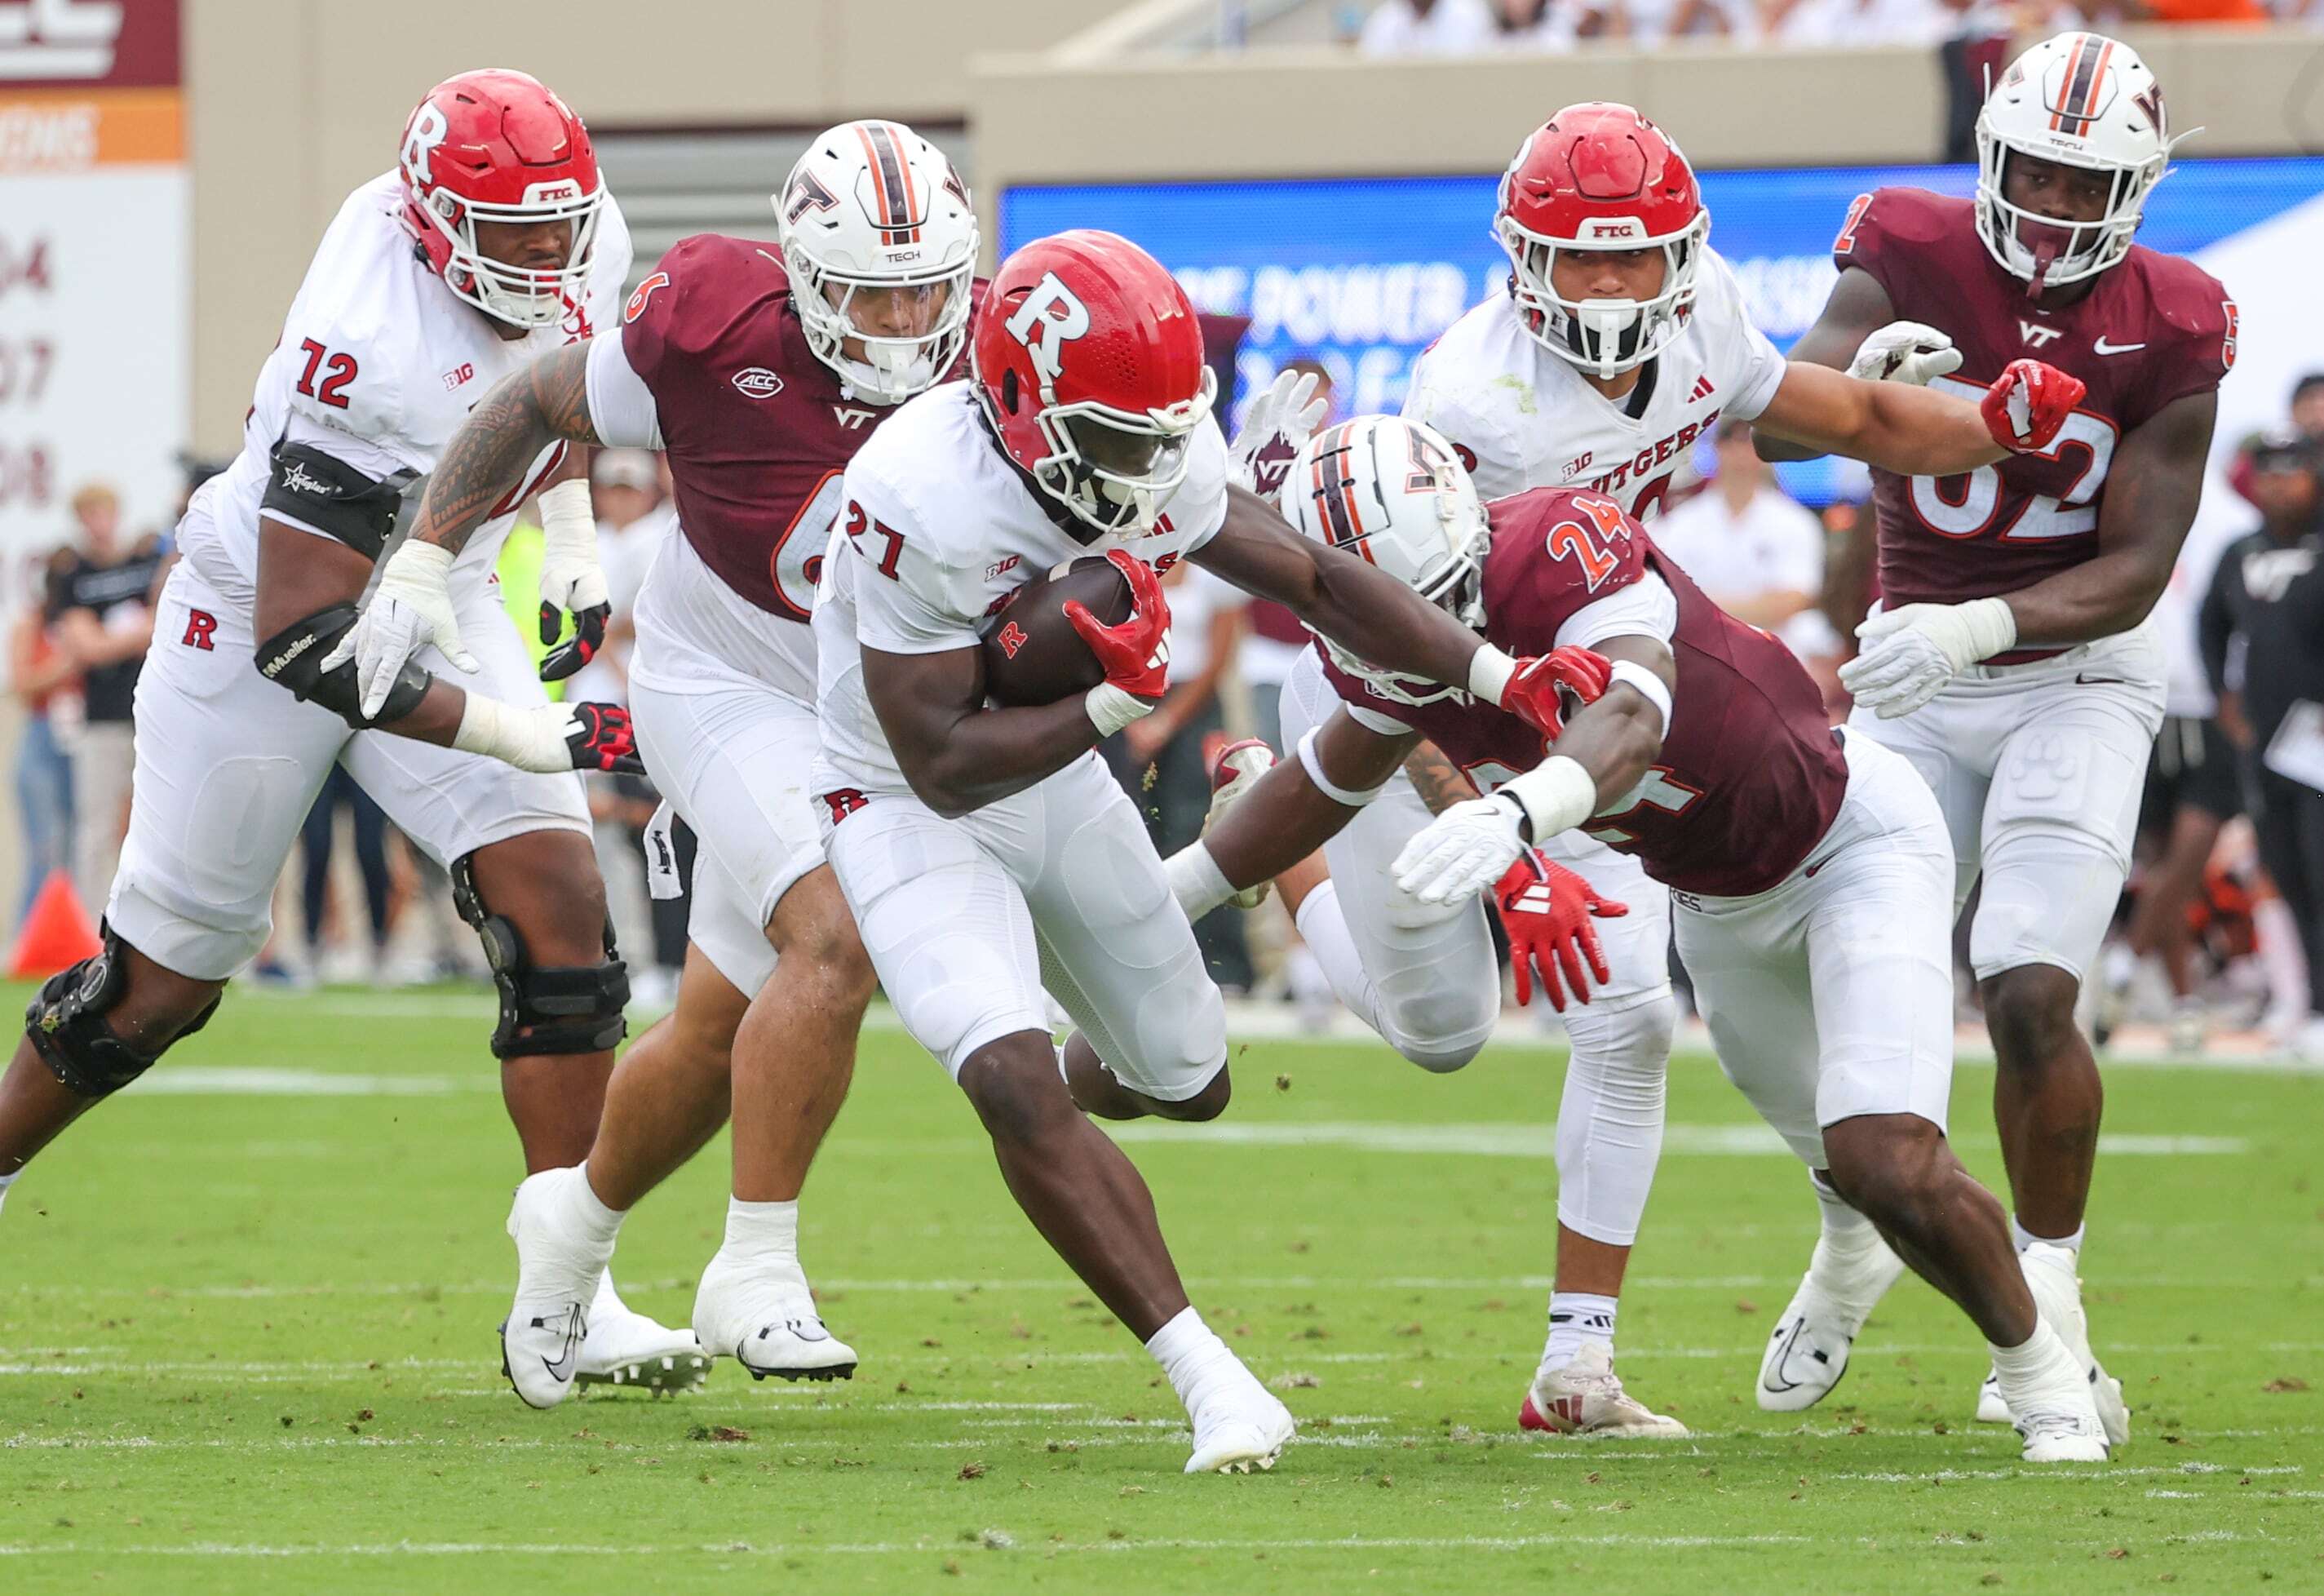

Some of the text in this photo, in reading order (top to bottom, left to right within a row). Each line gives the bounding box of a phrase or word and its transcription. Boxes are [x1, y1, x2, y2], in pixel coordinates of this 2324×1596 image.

[401, 100, 448, 184] R
[886, 250, 921, 264] TECH
[623, 271, 671, 324] 6
[1003, 269, 1091, 379] R
[2019, 320, 2063, 348] VT
[296, 336, 359, 410] 72
[740, 373, 777, 388] ACC
[833, 406, 877, 430] VT
[1546, 495, 1631, 594] 24
[182, 607, 219, 652] R
[997, 620, 1029, 660] R
[822, 787, 870, 827] R
